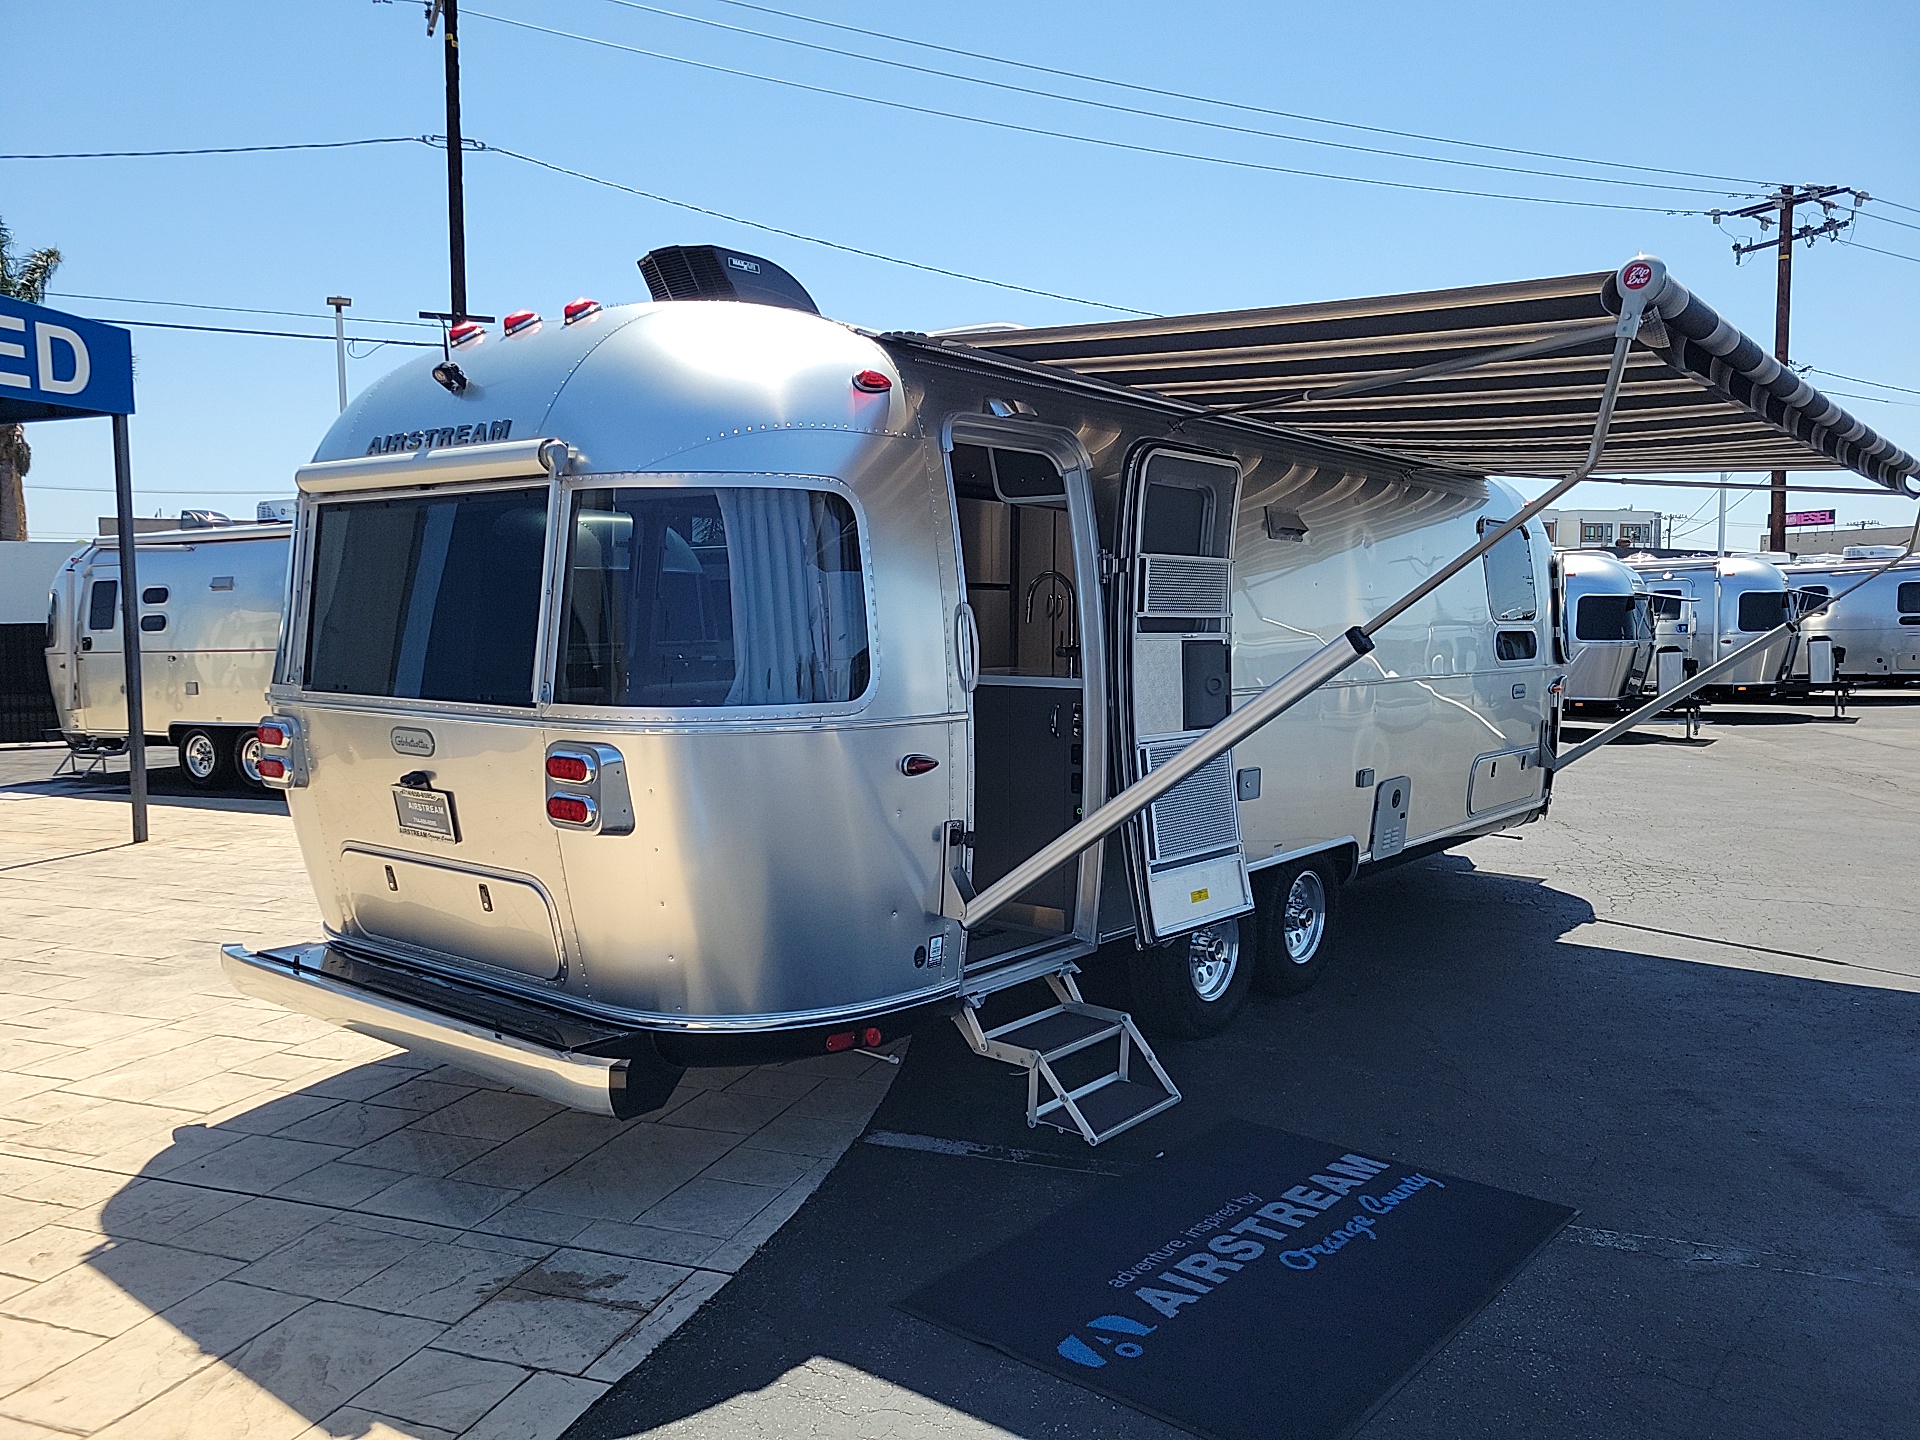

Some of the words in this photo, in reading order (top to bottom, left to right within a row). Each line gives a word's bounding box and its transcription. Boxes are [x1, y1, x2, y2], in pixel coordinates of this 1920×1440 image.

[366, 418, 512, 456] AIRSTREAM
[408, 801, 444, 815] AIRSTREAM
[399, 828, 428, 838] AIRSTREAM
[1134, 1153, 1391, 1319] AIRSTREAM
[1180, 1199, 1243, 1238] inspired
[1232, 1192, 1263, 1209] by
[1279, 1213, 1377, 1271] Orange
[1358, 1172, 1447, 1215] County
